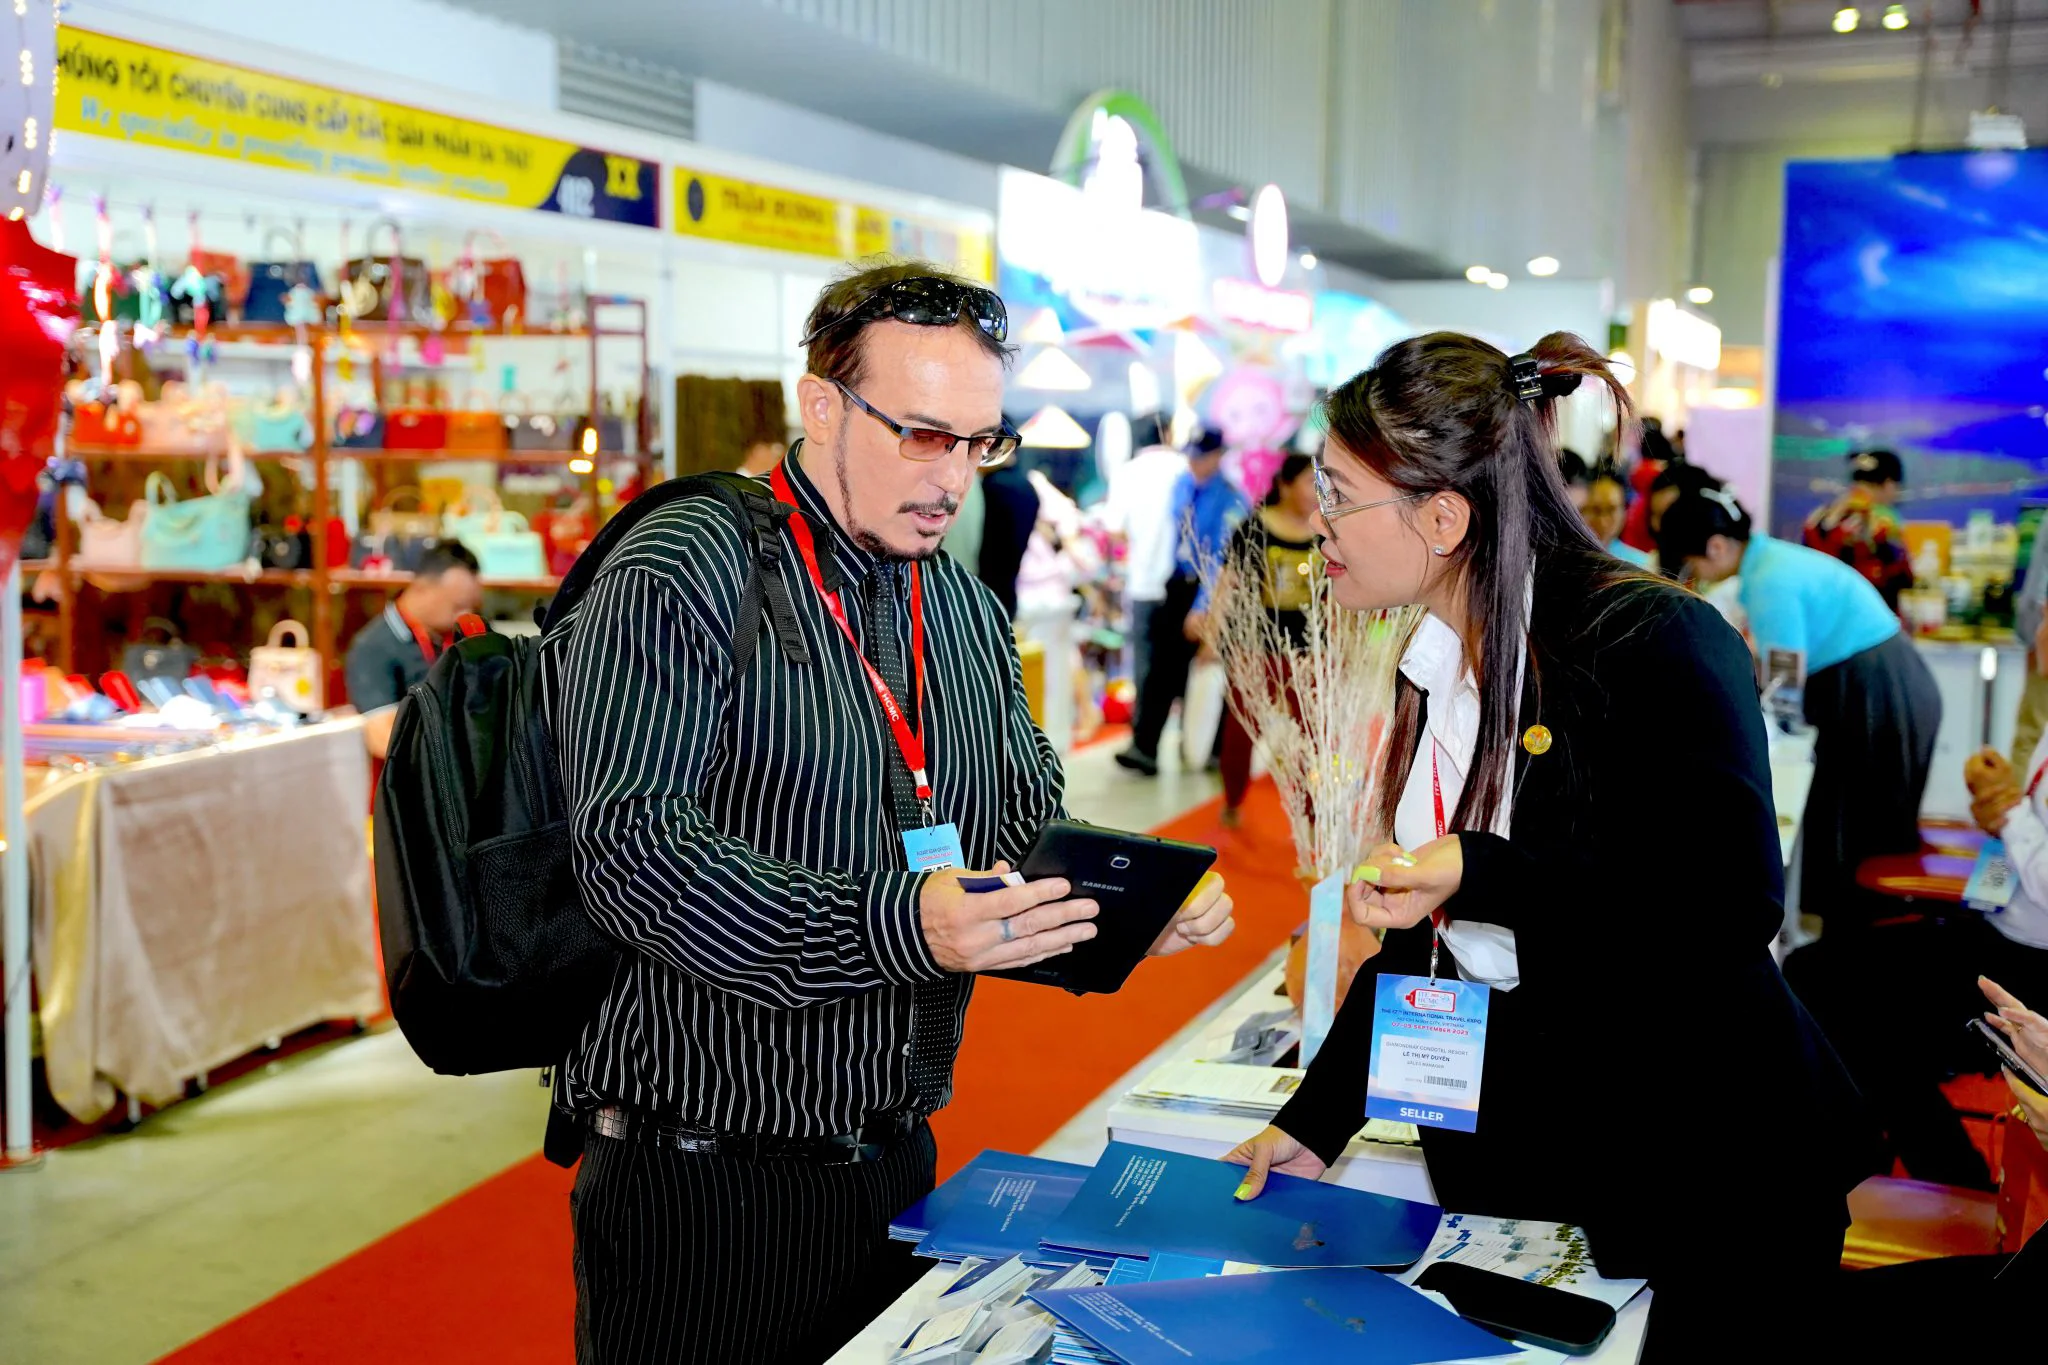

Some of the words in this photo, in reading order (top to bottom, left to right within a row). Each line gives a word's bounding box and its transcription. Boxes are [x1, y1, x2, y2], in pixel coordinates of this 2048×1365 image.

[57, 41, 120, 86] HÚNG
[881, 693, 900, 722] HCMC
[1082, 880, 1126, 892] SAMSUNG
[1402, 1011, 1444, 1019] INTERNATIONAL
[1413, 1024, 1450, 1033] SEPTEMBER
[1400, 1107, 1444, 1122] SELLER
